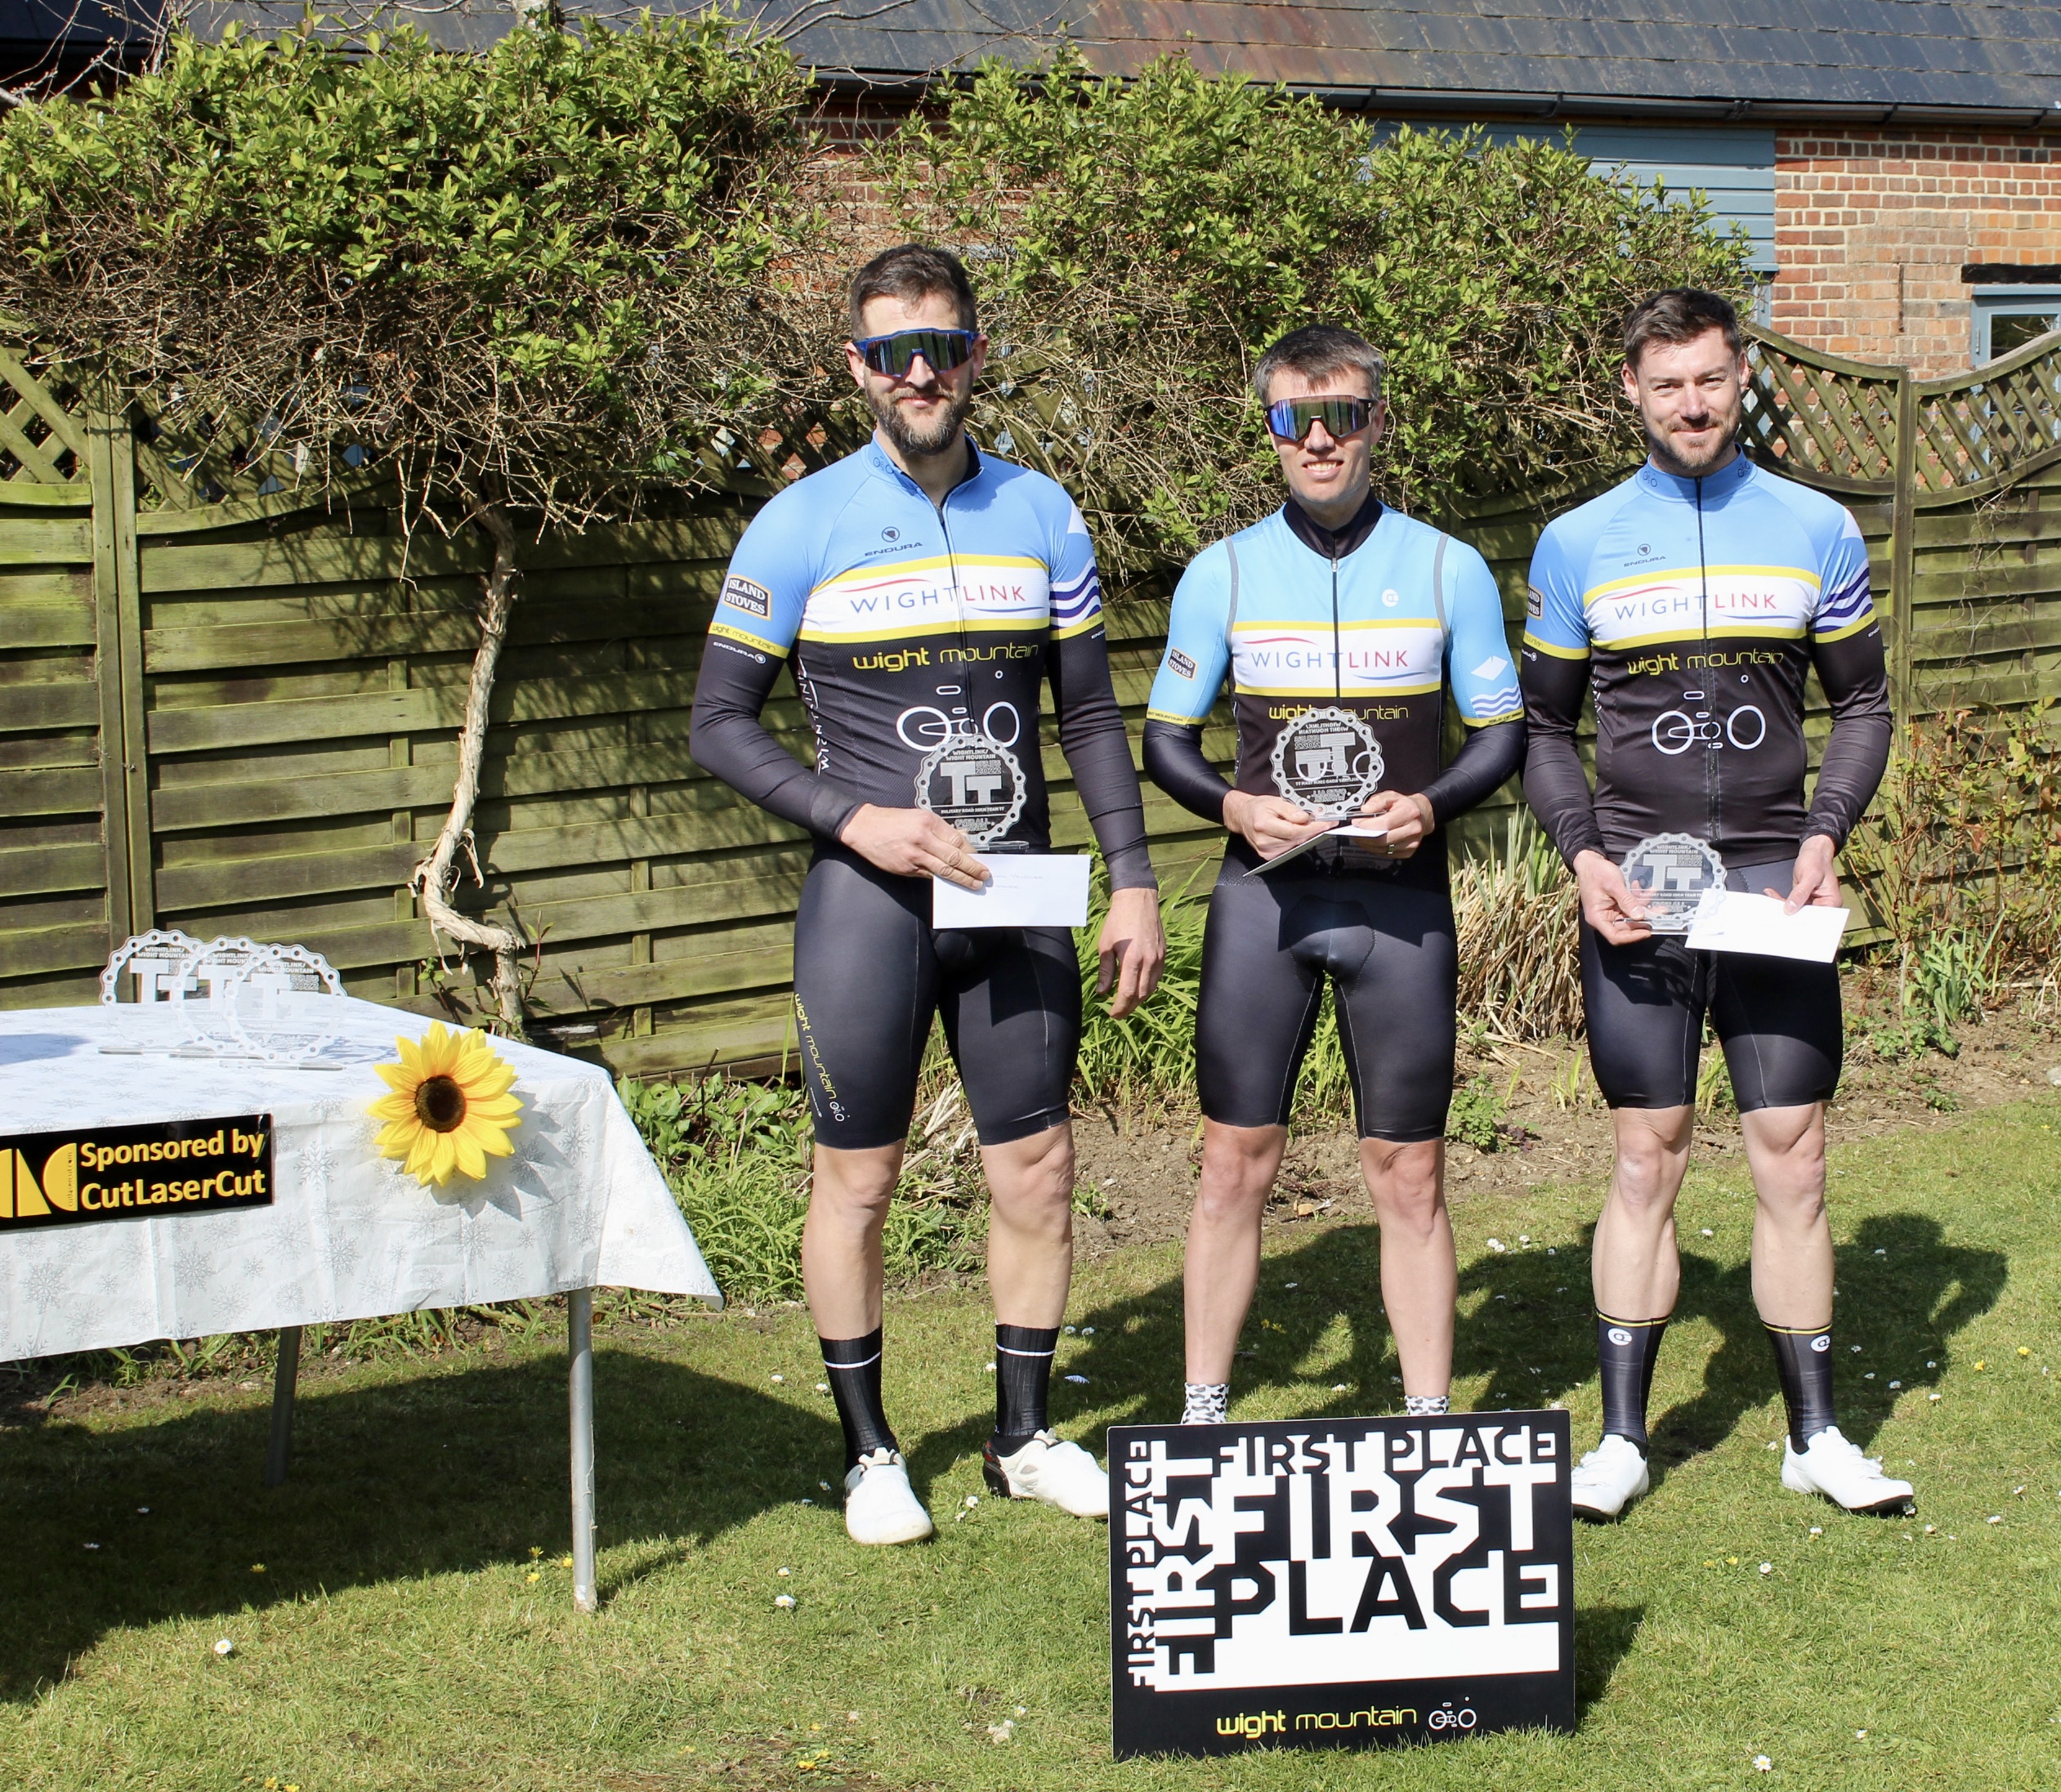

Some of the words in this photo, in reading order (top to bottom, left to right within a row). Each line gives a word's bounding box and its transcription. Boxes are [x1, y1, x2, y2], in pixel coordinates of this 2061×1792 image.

[865, 542, 923, 556] ENDURA
[1624, 556, 1665, 567] ENDURA
[726, 592, 765, 614] STOVES
[729, 579, 766, 601] ISLAND
[851, 585, 1026, 613] WIGHTLINK
[1615, 593, 1777, 620] WIGHTLINK
[713, 625, 730, 634] wight
[732, 631, 776, 651] mountain
[713, 641, 755, 659] ENDURA
[853, 646, 930, 673] wight
[940, 642, 1039, 664] mountain
[1169, 659, 1191, 677] STOVES
[1172, 650, 1193, 668] ISLAND
[1251, 650, 1409, 668] WIGHTLINK
[1627, 653, 1679, 676] wight
[1687, 648, 1784, 669] mountain
[976, 766, 1002, 775] 2022
[291, 982, 319, 990] 2022
[795, 993, 811, 1031] wight
[806, 1035, 837, 1100] mountain
[81, 1130, 224, 1172] Sponsored
[232, 1128, 265, 1158] by
[82, 1170, 266, 1210] CutLaserCut
[1212, 1434, 1366, 1476] FIRST
[1385, 1427, 1556, 1471] PLACE
[1124, 1441, 1155, 1568] PLACE
[1212, 1463, 1557, 1564] FIRST
[1151, 1440, 1216, 1691] FIRST
[1214, 1551, 1560, 1639] PLACE
[1127, 1582, 1155, 1687] FIRST
[1216, 1709, 1286, 1739] wight
[1295, 1705, 1417, 1731] mountain
